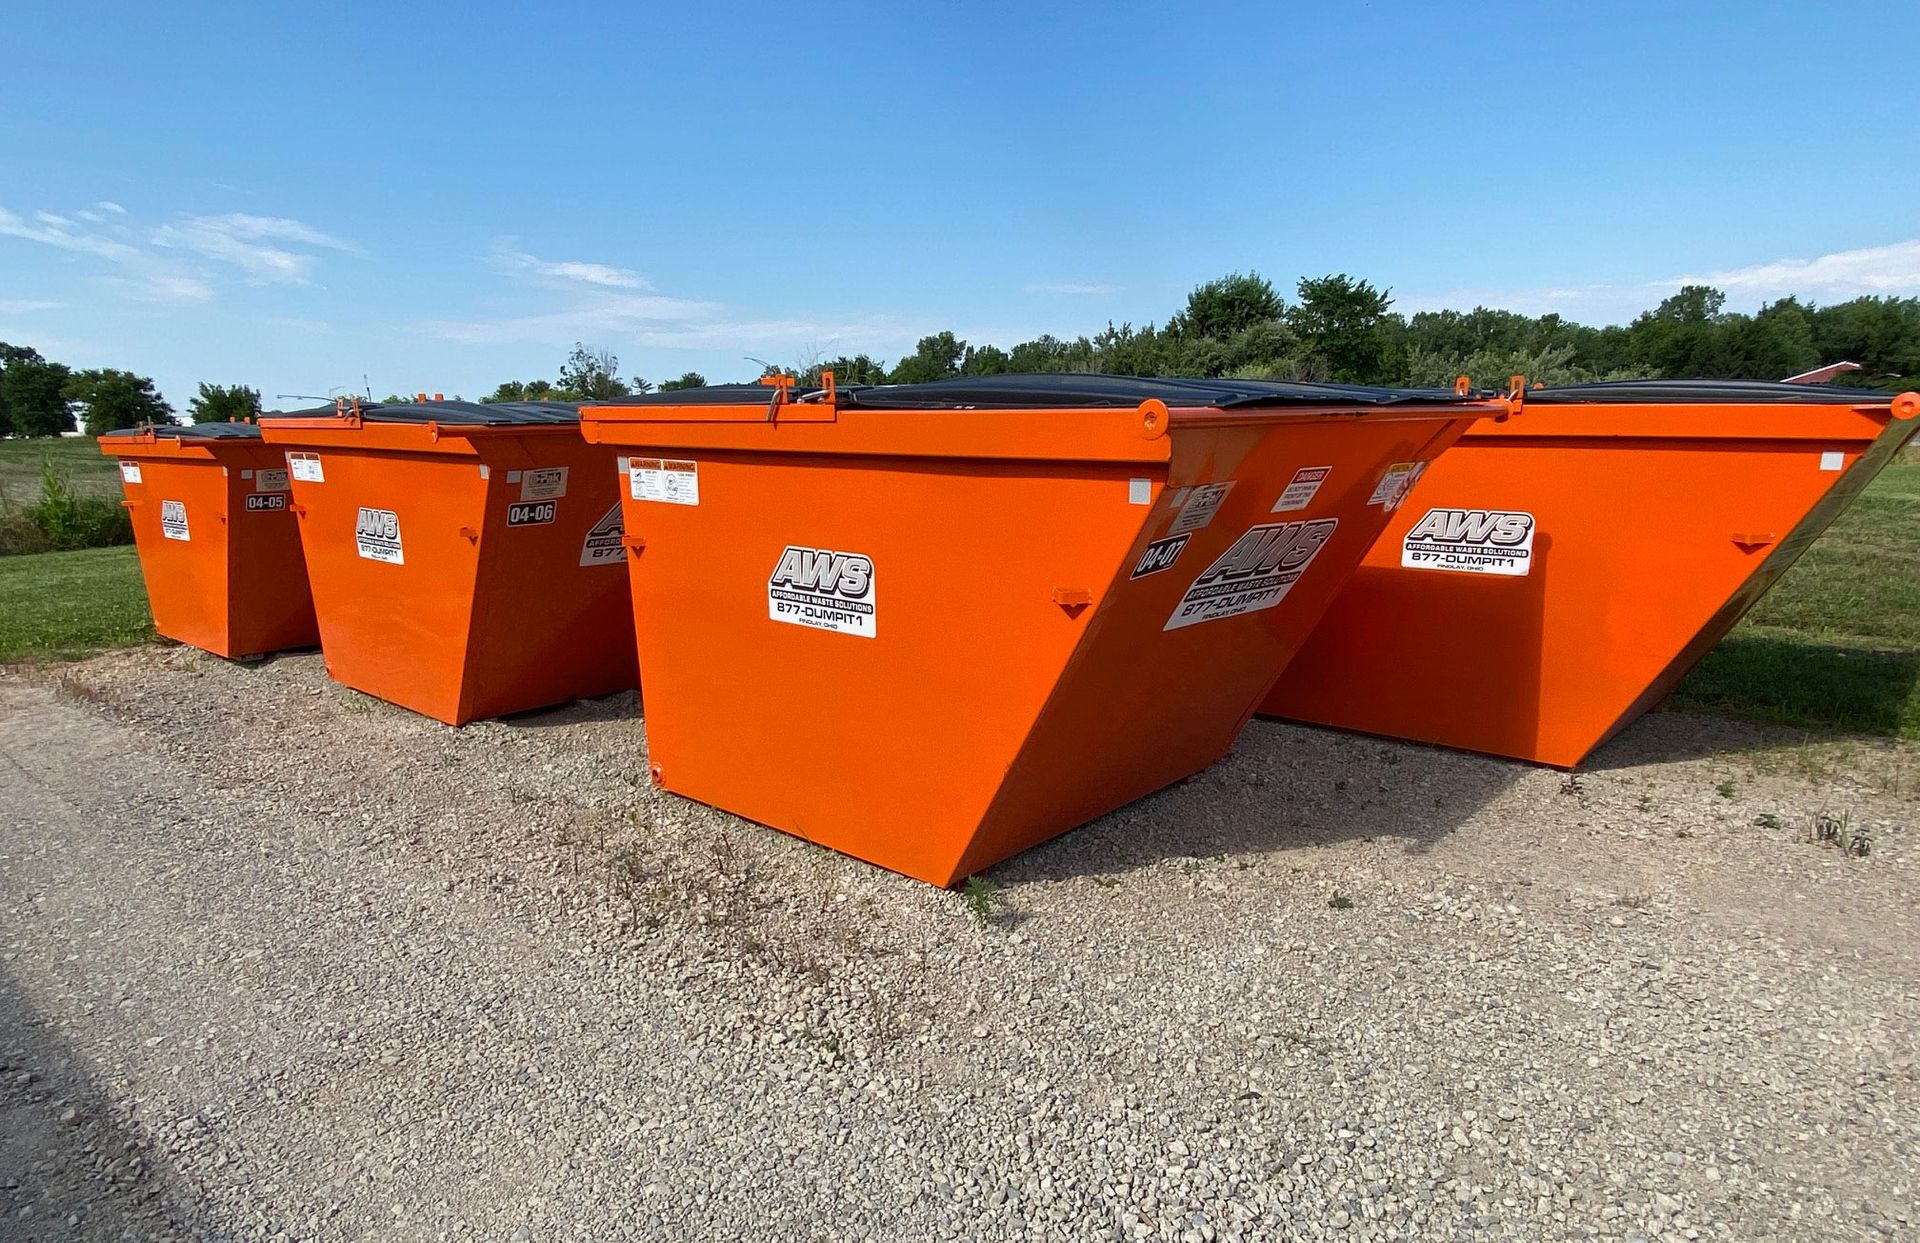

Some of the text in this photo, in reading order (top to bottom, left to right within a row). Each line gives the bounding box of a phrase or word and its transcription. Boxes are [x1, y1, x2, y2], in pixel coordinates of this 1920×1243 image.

[249, 496, 283, 508] 04-05
[510, 504, 553, 523] 04-06
[357, 509, 397, 540] AWS
[1407, 510, 1533, 546] AWS
[589, 538, 621, 546] AFFORD
[1195, 519, 1336, 586] AWS
[1407, 543, 1527, 557] AFFORDABLE WASTE SOLUTIONS
[1137, 540, 1185, 573] 04-07
[1412, 553, 1515, 567] 877-DUMPIT1
[771, 548, 872, 599] AWS
[1188, 573, 1299, 601] AFFORDABLE WASTE SOLUTIONS
[772, 591, 872, 613] AFFORDABLE WASTE SOLUTIONS
[1181, 586, 1281, 617] 877-DUMPIT1
[777, 603, 863, 626] 877-DUMPIT1
